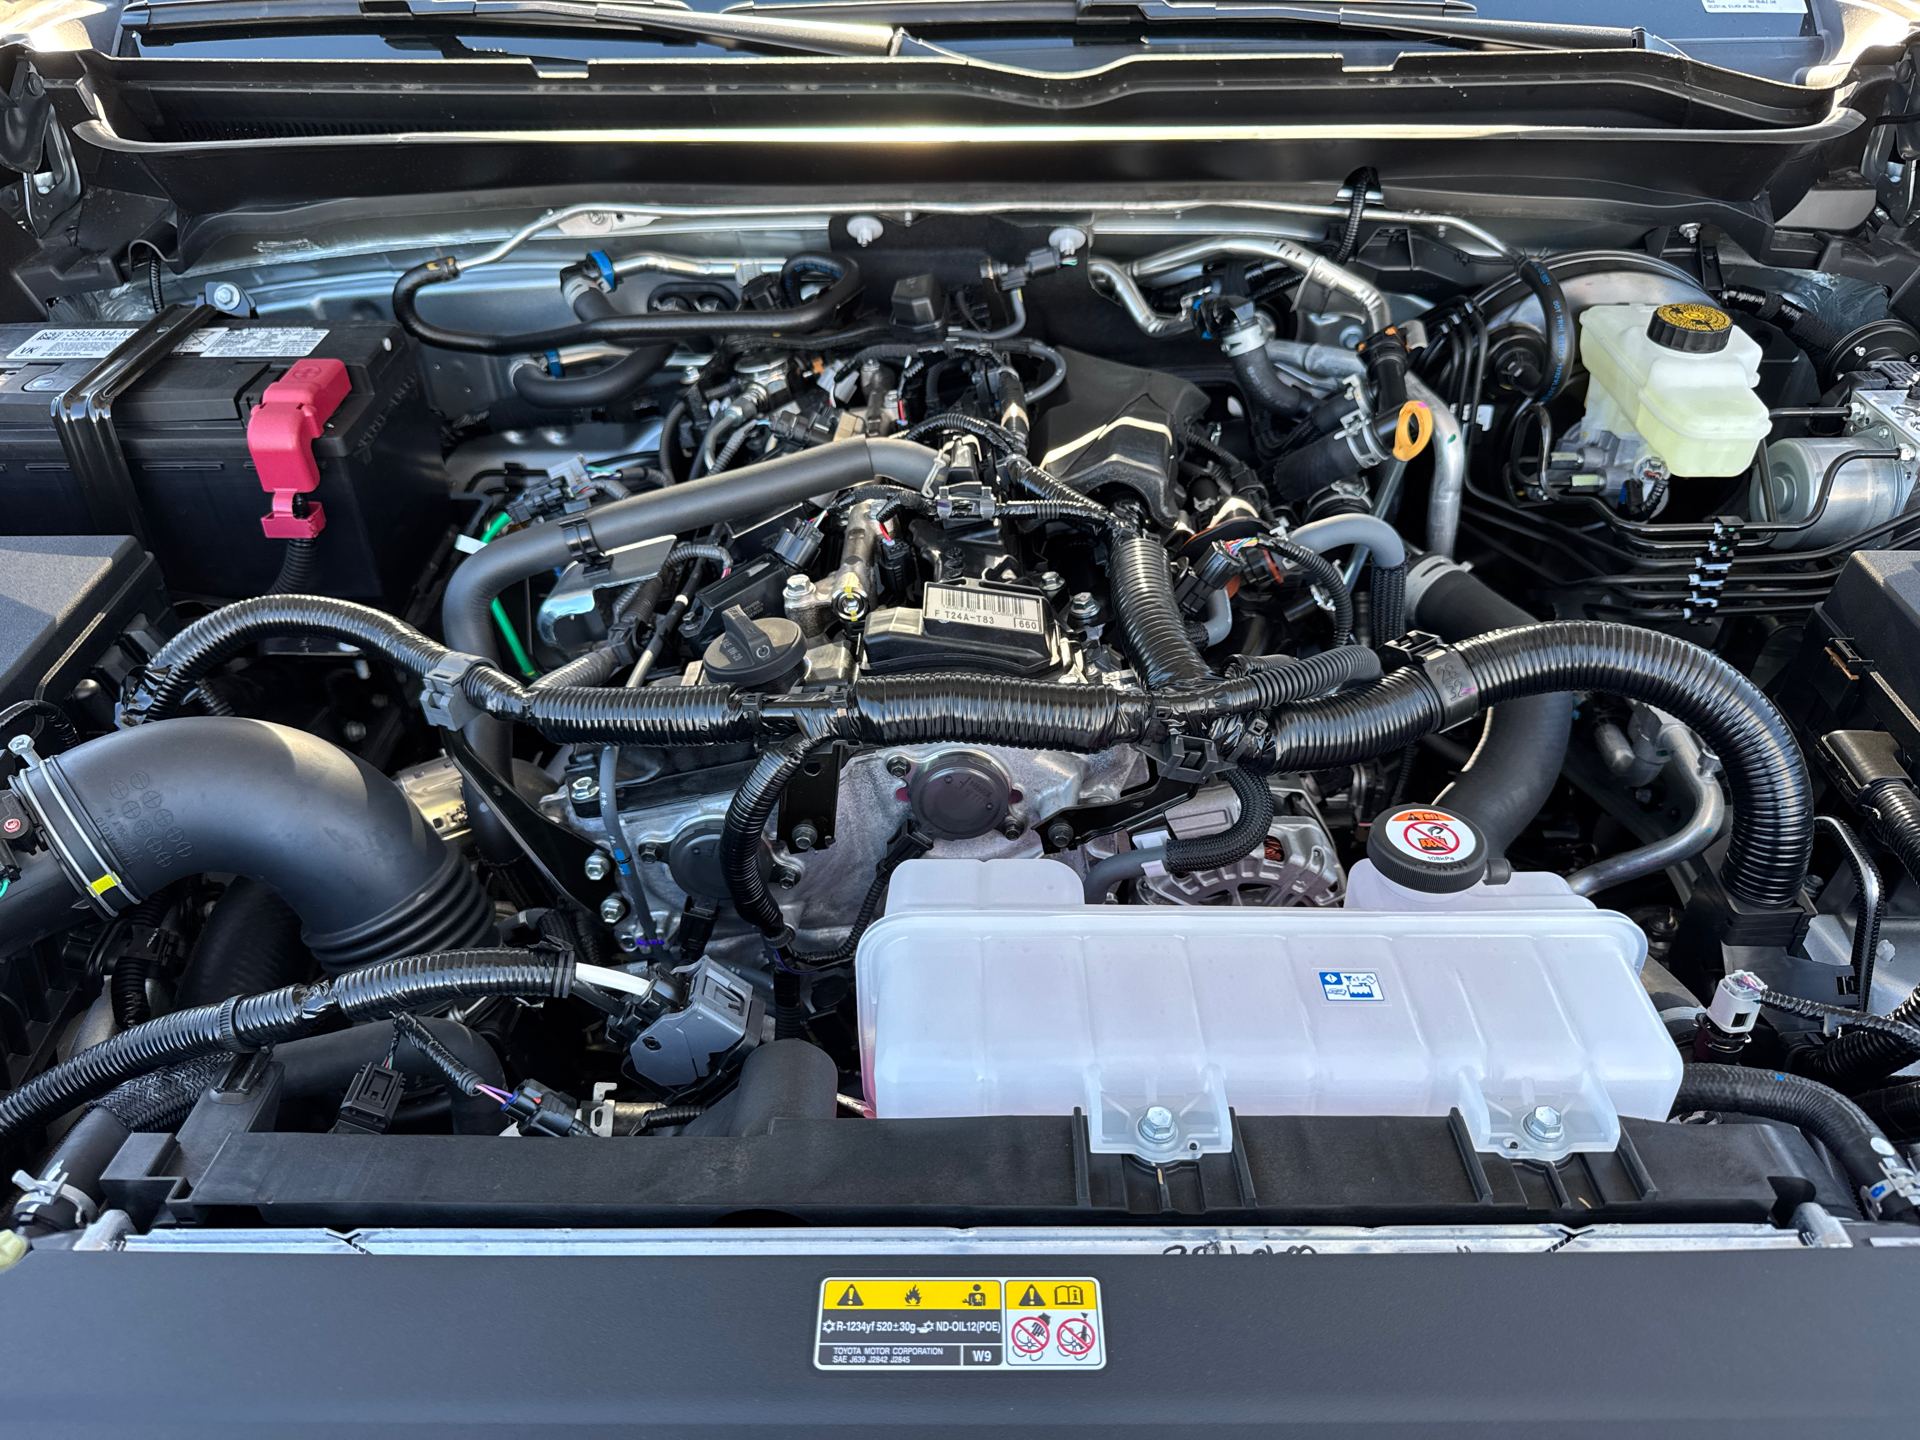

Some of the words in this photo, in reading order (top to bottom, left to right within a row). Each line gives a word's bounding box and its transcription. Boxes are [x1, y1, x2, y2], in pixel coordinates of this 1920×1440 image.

[934, 609, 940, 617] F
[945, 611, 995, 625] T24A-T83
[1018, 621, 1037, 630] 660
[836, 1321, 875, 1334] R-1234yf
[877, 1321, 917, 1334] 520±30g
[935, 1321, 1001, 1334] ND-OIL12(POE)
[833, 1347, 862, 1355] TOYOTA
[864, 1347, 890, 1355] MOTOR
[892, 1347, 944, 1355] CORPORATION
[972, 1350, 992, 1362] W9
